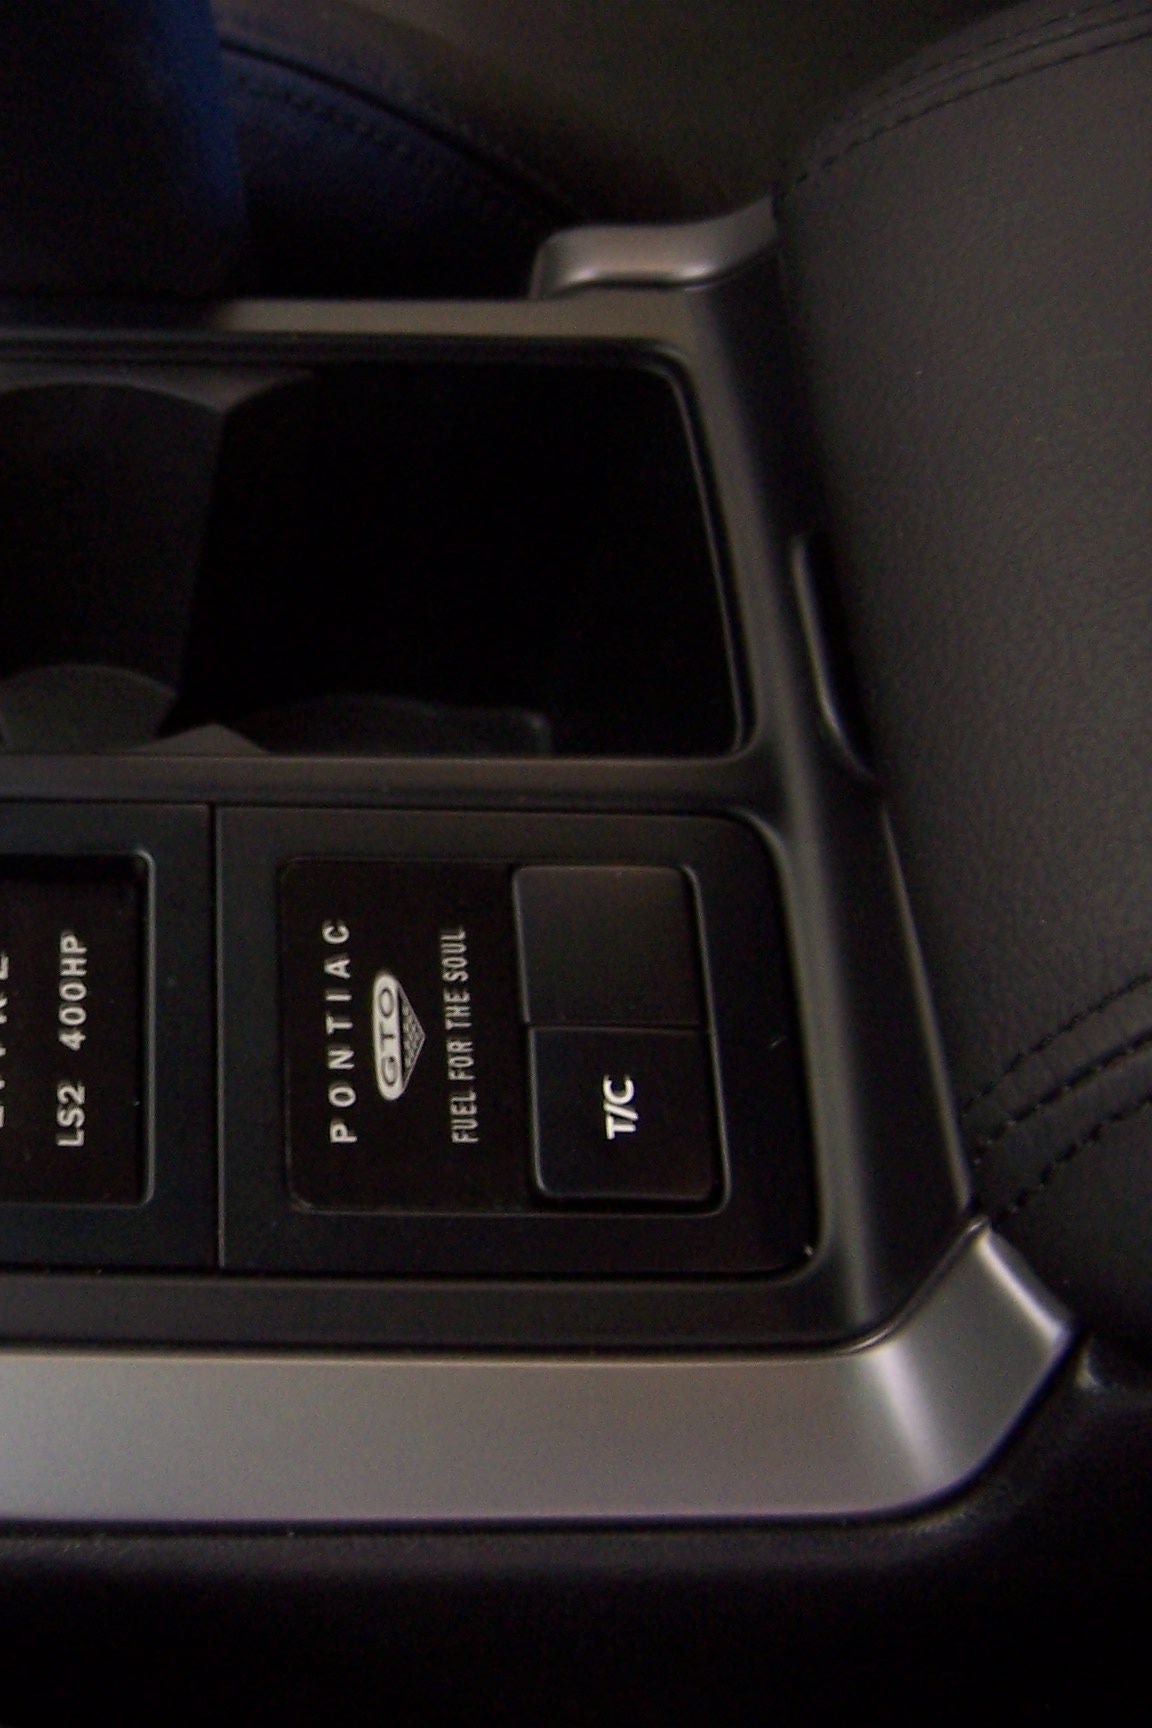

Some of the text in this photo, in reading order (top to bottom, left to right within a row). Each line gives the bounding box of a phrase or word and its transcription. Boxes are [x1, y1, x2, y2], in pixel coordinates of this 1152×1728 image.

[56, 934, 88, 1147] LS2 400HP
[322, 921, 358, 1144] PONTIAC
[379, 987, 398, 1087] GTO
[440, 930, 479, 1144] FUEL FOR THE SOUL
[601, 1076, 638, 1141] T/C
